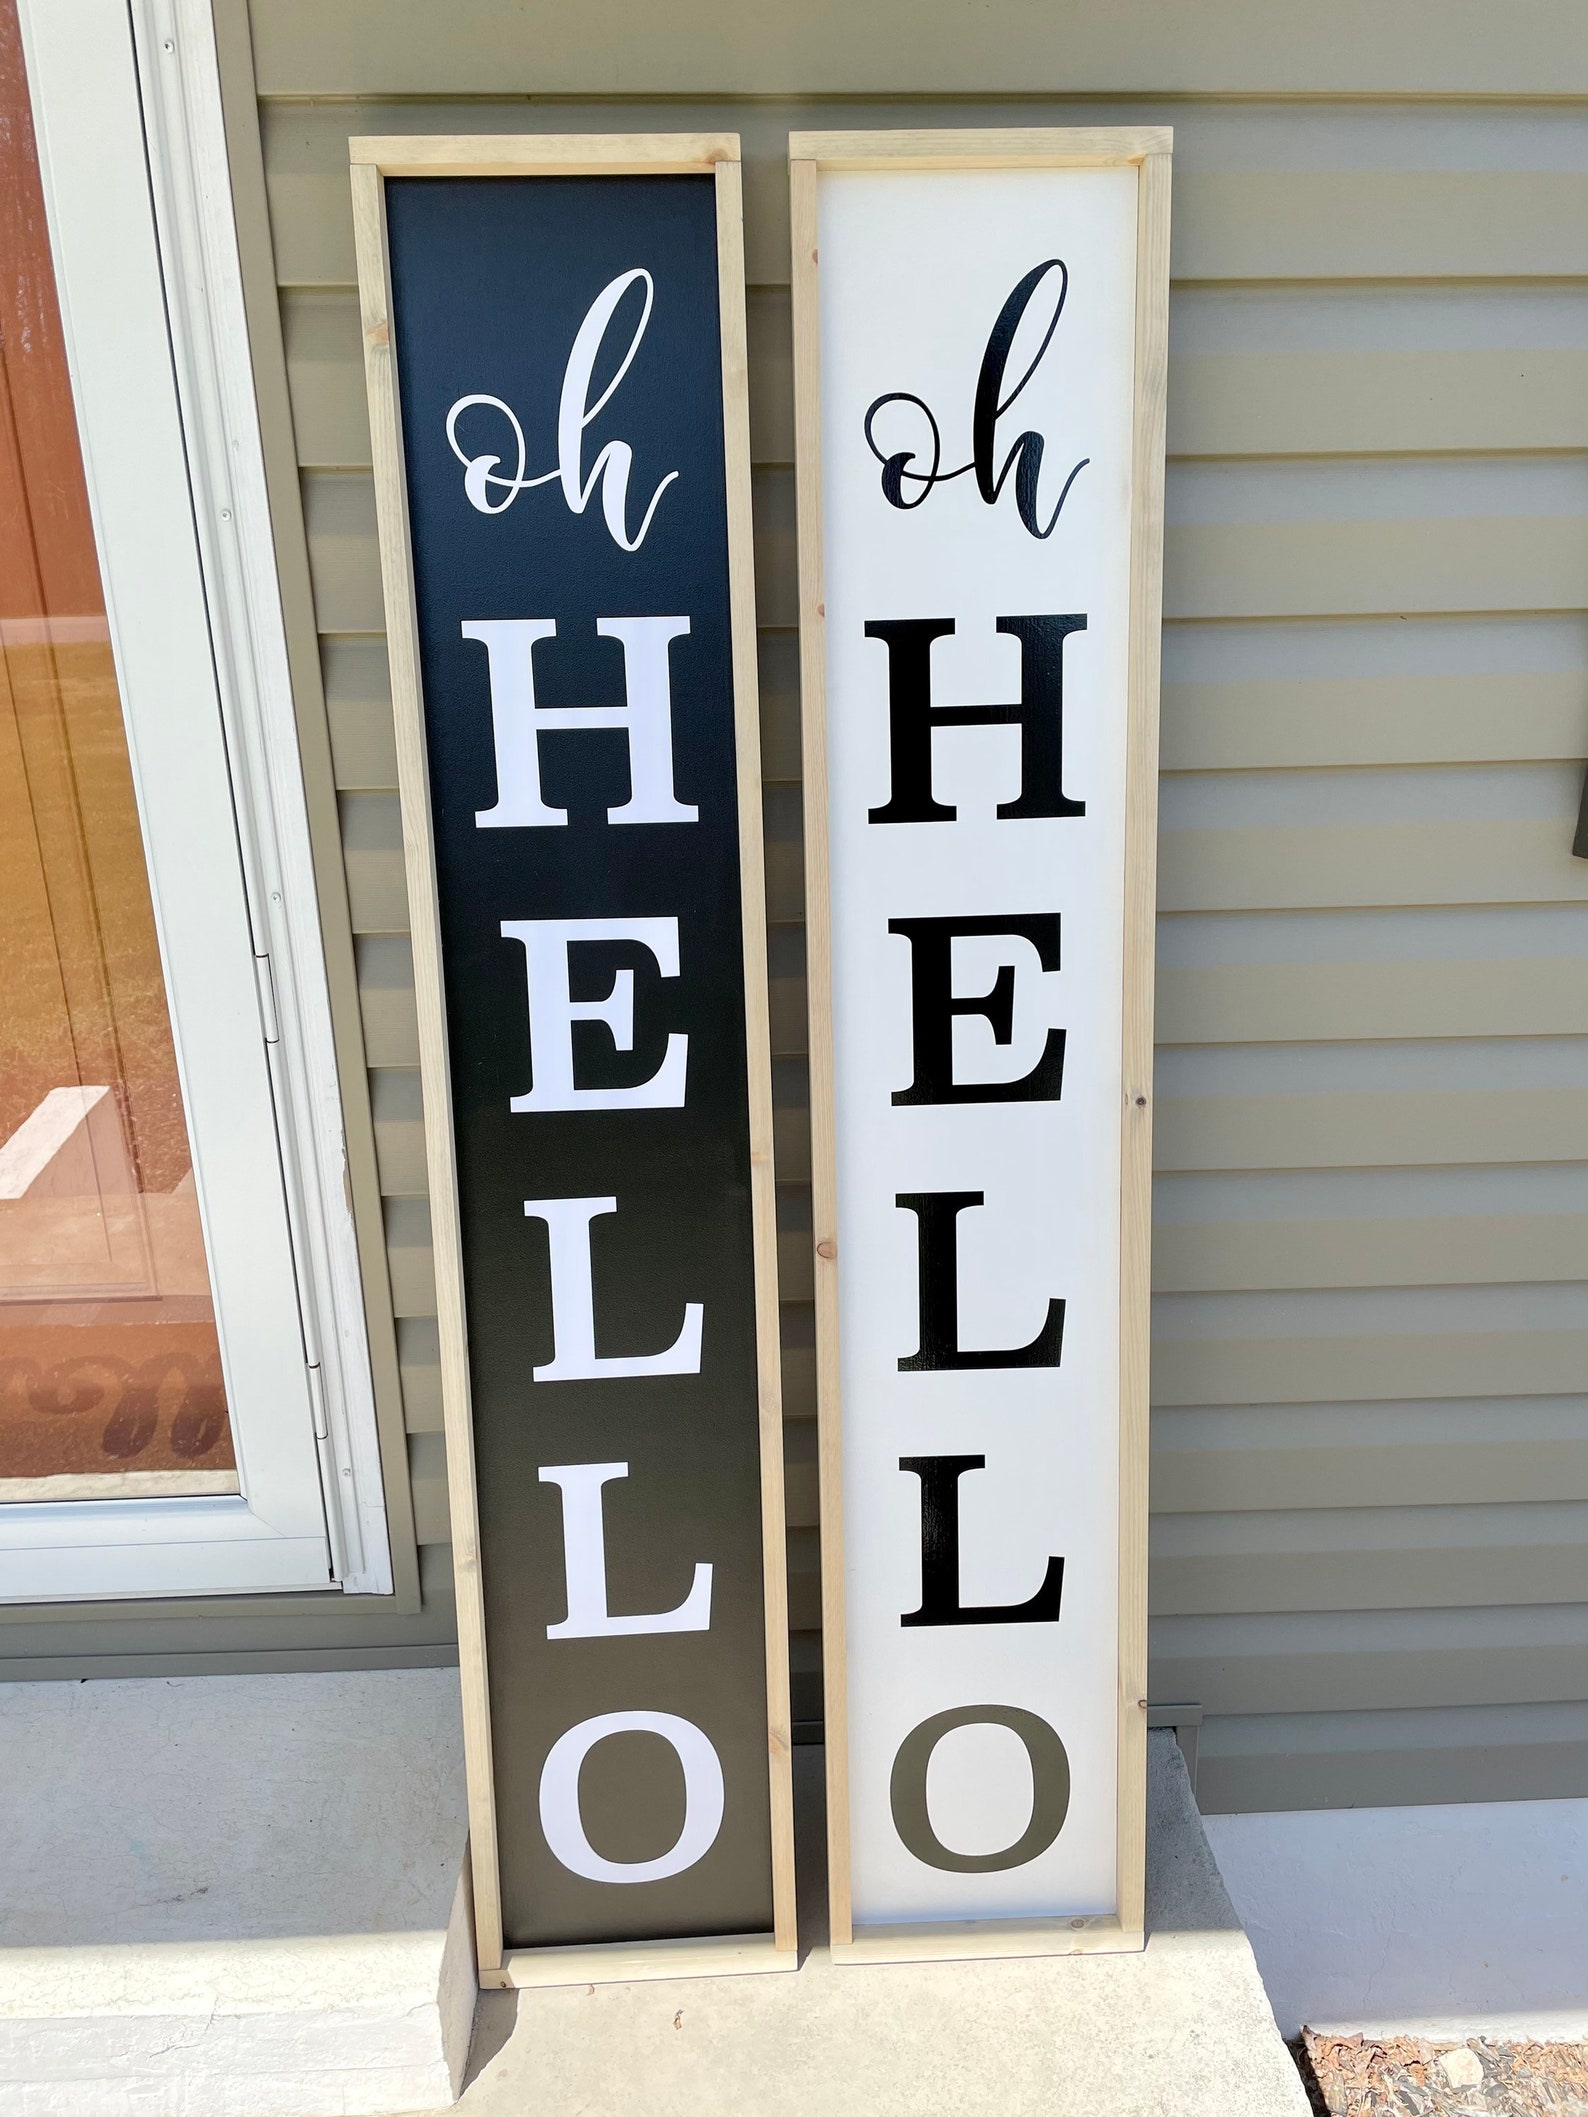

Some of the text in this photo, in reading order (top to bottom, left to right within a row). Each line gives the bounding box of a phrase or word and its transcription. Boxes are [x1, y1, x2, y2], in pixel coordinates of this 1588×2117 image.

[446, 269, 678, 551] oh
[864, 259, 1089, 539] oh
[460, 616, 725, 1884] HELLO
[864, 614, 1087, 1873] HELLO
